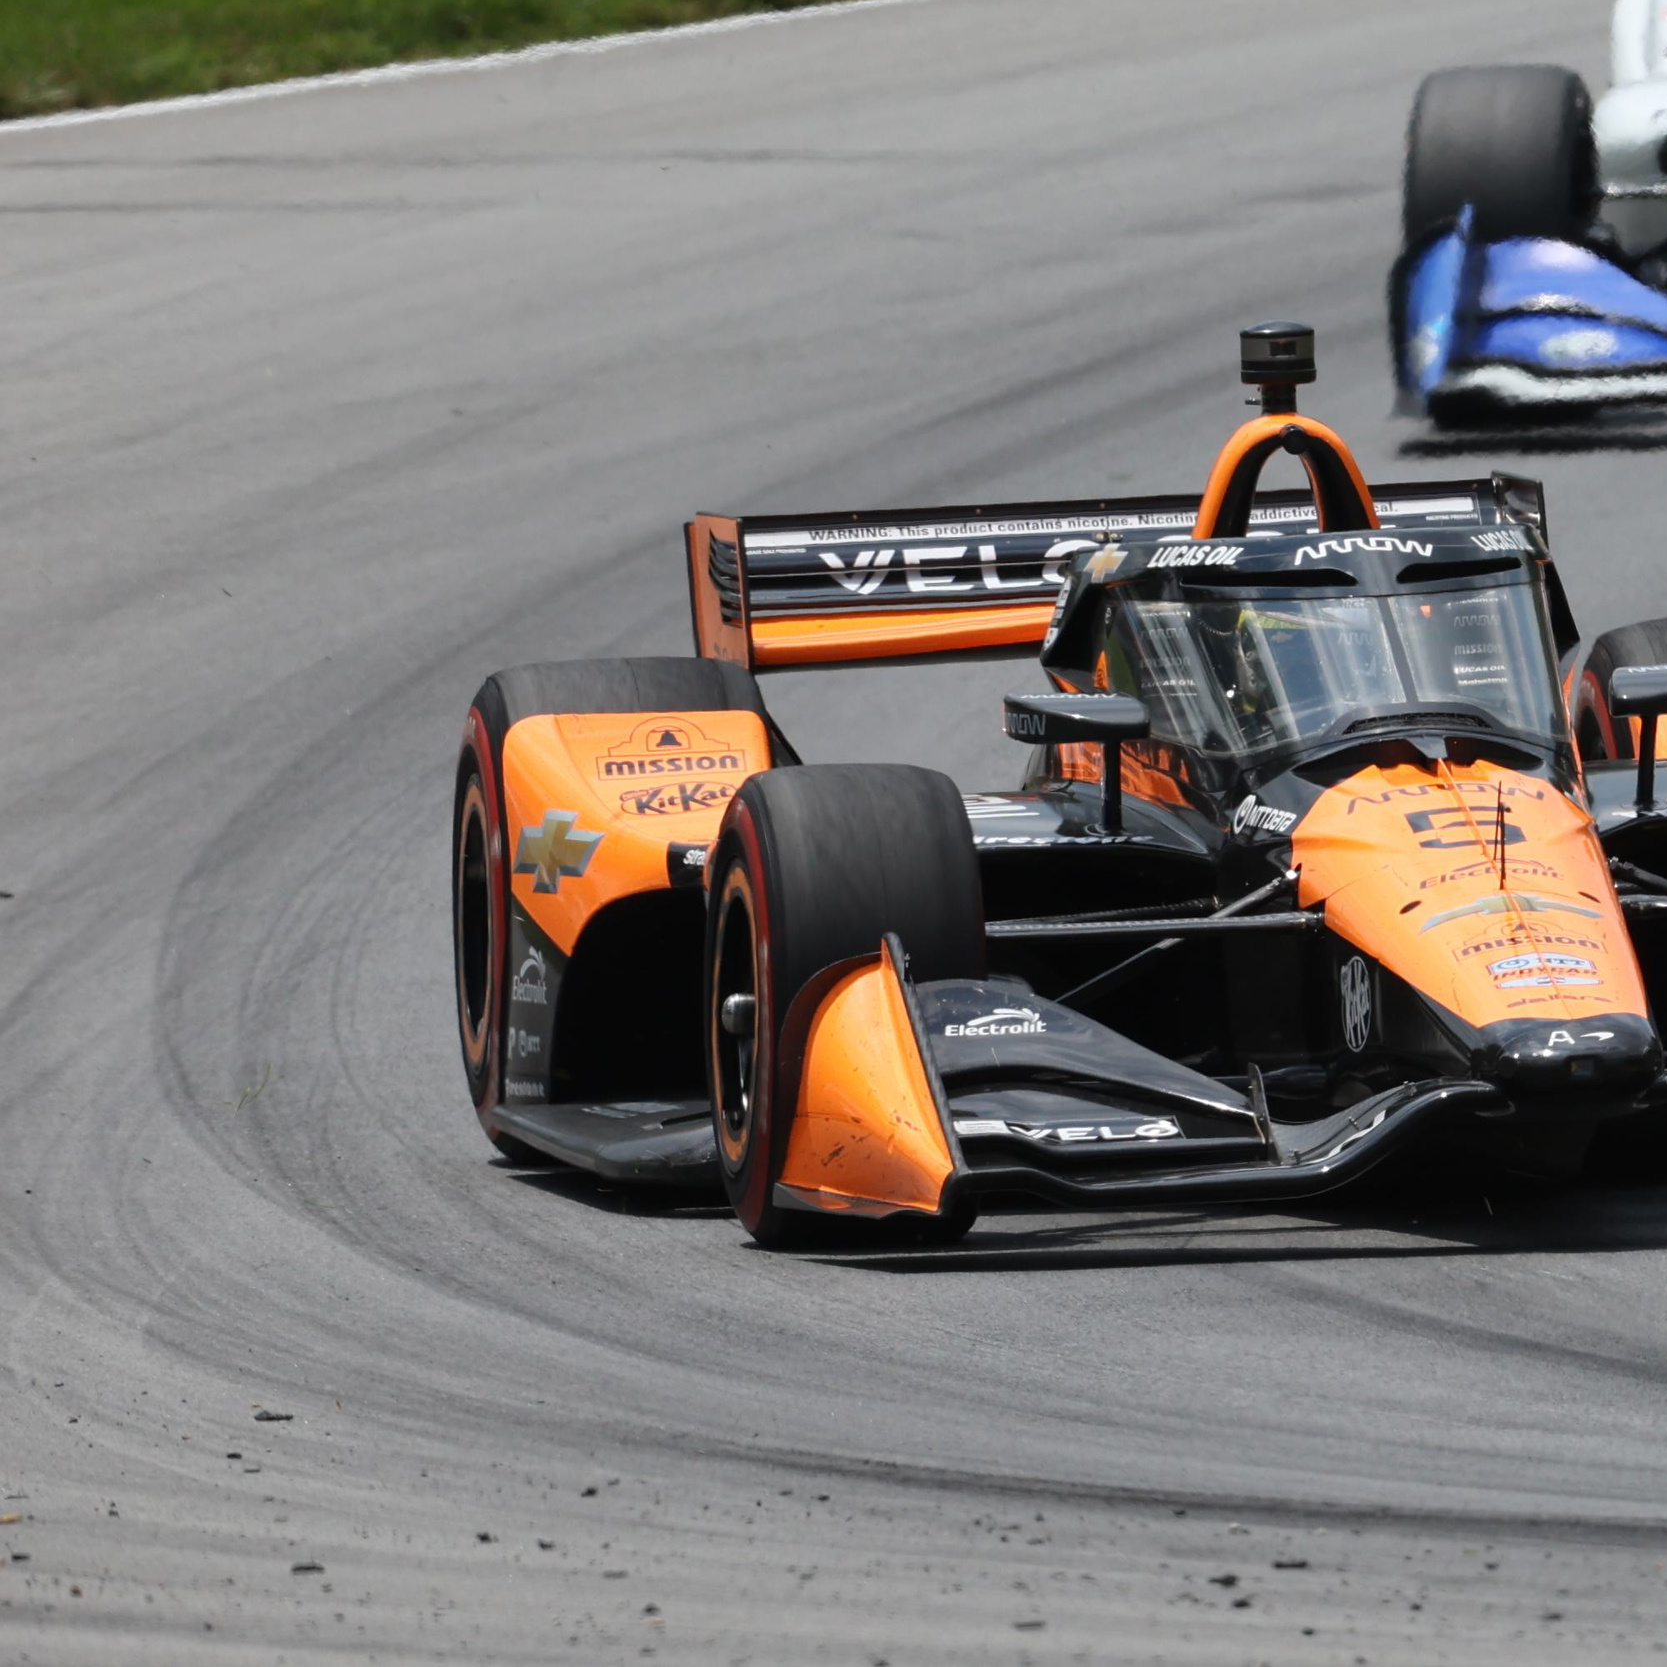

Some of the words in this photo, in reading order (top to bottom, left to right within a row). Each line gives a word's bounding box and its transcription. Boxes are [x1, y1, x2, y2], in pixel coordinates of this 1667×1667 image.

[808, 526, 893, 542] WARNING:
[898, 525, 930, 538] This
[934, 522, 996, 538] product
[998, 519, 1063, 534] contains
[1067, 515, 1134, 530] nicotine.
[1138, 512, 1198, 526] Nicotin
[1250, 507, 1319, 522] addictive
[1293, 536, 1434, 566] ARROW
[1470, 530, 1515, 552] LUCAS
[1147, 545, 1207, 568] LUCAS
[1203, 545, 1245, 566] OIL
[604, 754, 740, 777] mission
[634, 783, 732, 815] KitKat
[1346, 783, 1545, 815] ARROW
[1404, 806, 1528, 849] 5
[1419, 865, 1565, 890] Electrolit
[1461, 935, 1600, 957] mission
[944, 1020, 1047, 1037] Electrolit
[1008, 1120, 1180, 1142] VELO
